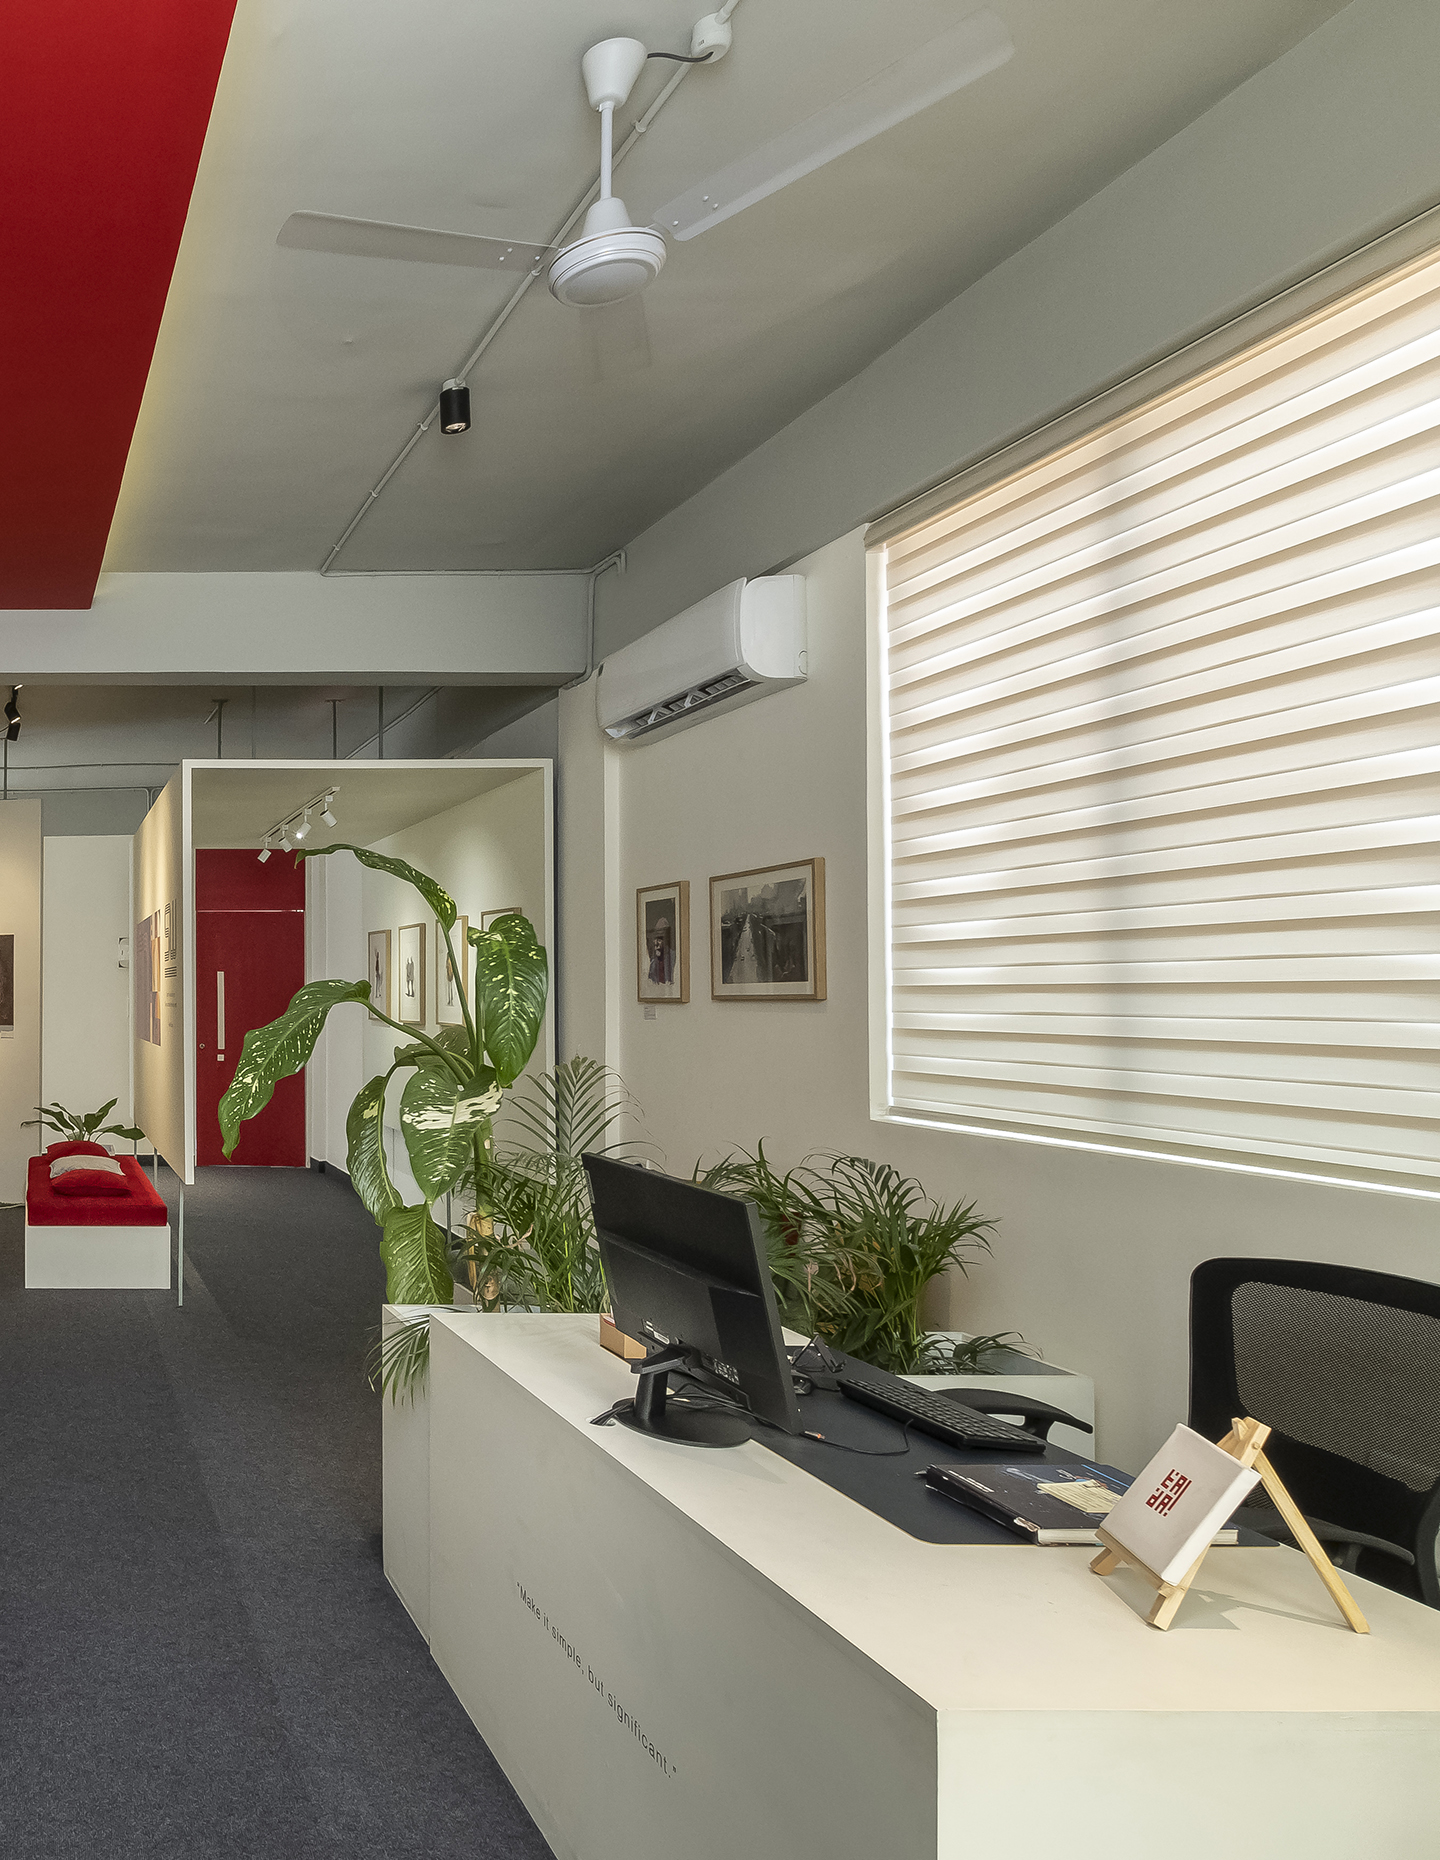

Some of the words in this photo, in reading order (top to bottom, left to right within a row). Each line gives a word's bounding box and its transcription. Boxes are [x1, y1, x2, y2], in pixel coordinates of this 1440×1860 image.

[543, 1612, 550, 1631] it
[551, 1624, 585, 1675] simple,
[587, 1664, 606, 1697] but
[607, 1691, 678, 1779] significant."
